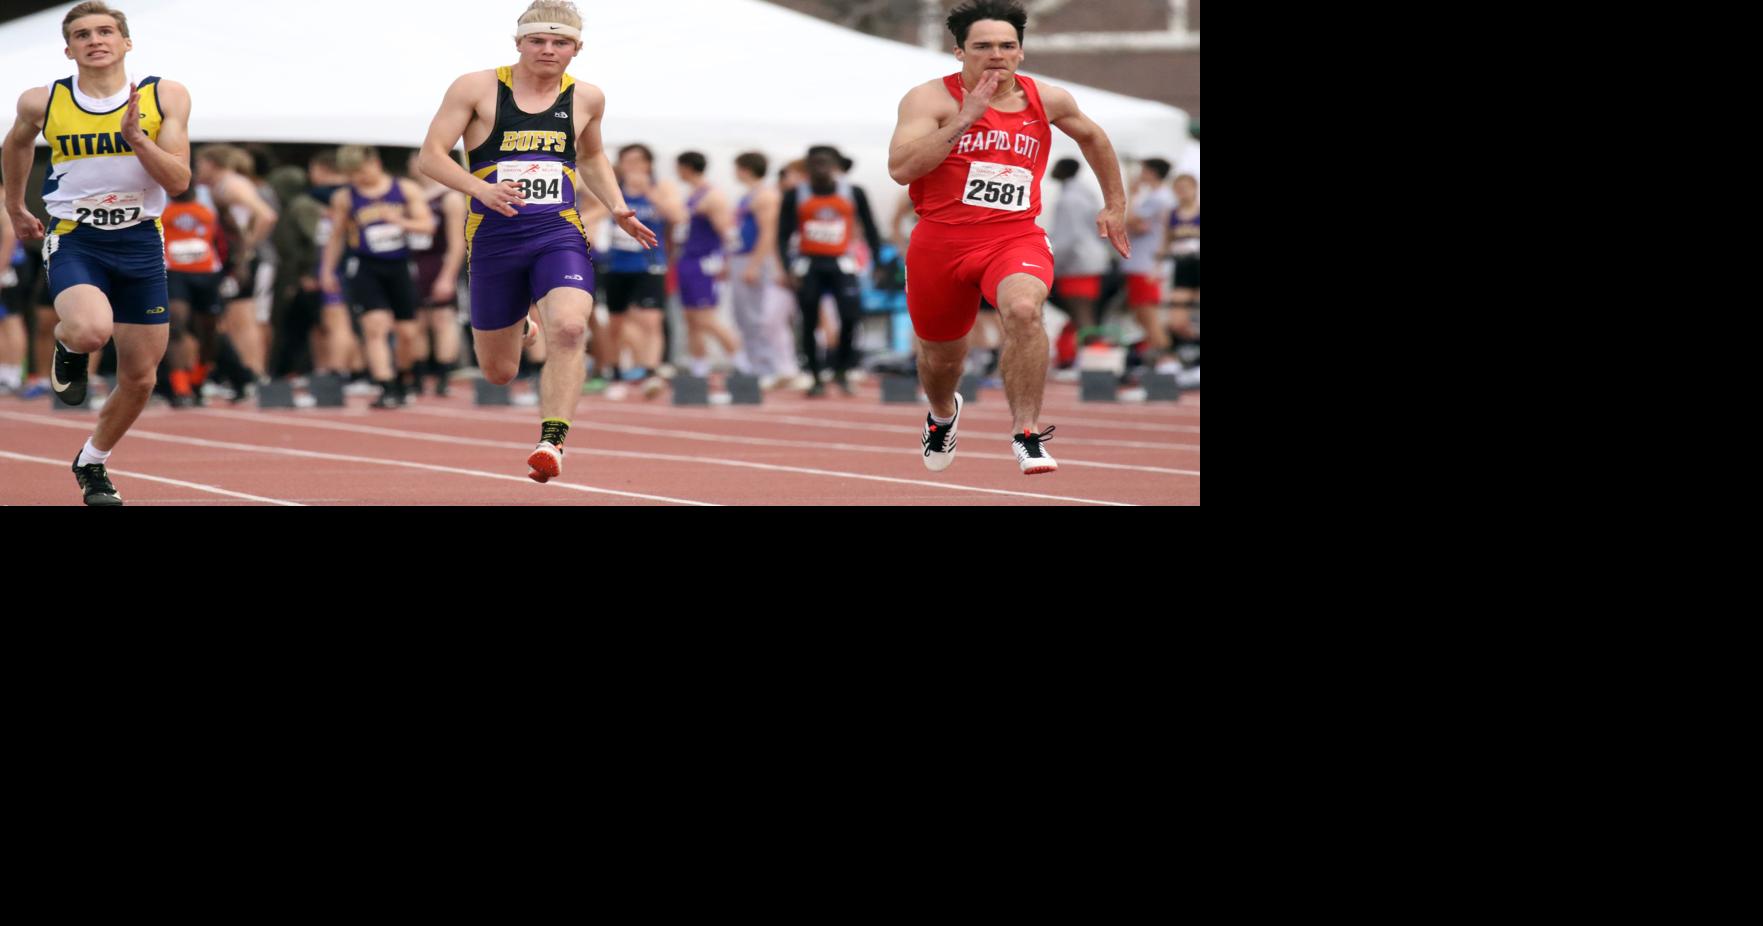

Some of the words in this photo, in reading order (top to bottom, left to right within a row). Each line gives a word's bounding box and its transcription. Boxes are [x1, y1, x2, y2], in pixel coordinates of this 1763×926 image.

[56, 131, 149, 156] TITAN
[500, 130, 567, 153] BUFFS
[956, 129, 1011, 154] RAPID
[501, 178, 560, 200] 894
[966, 178, 1025, 206] 2581
[76, 206, 141, 226] 2967
